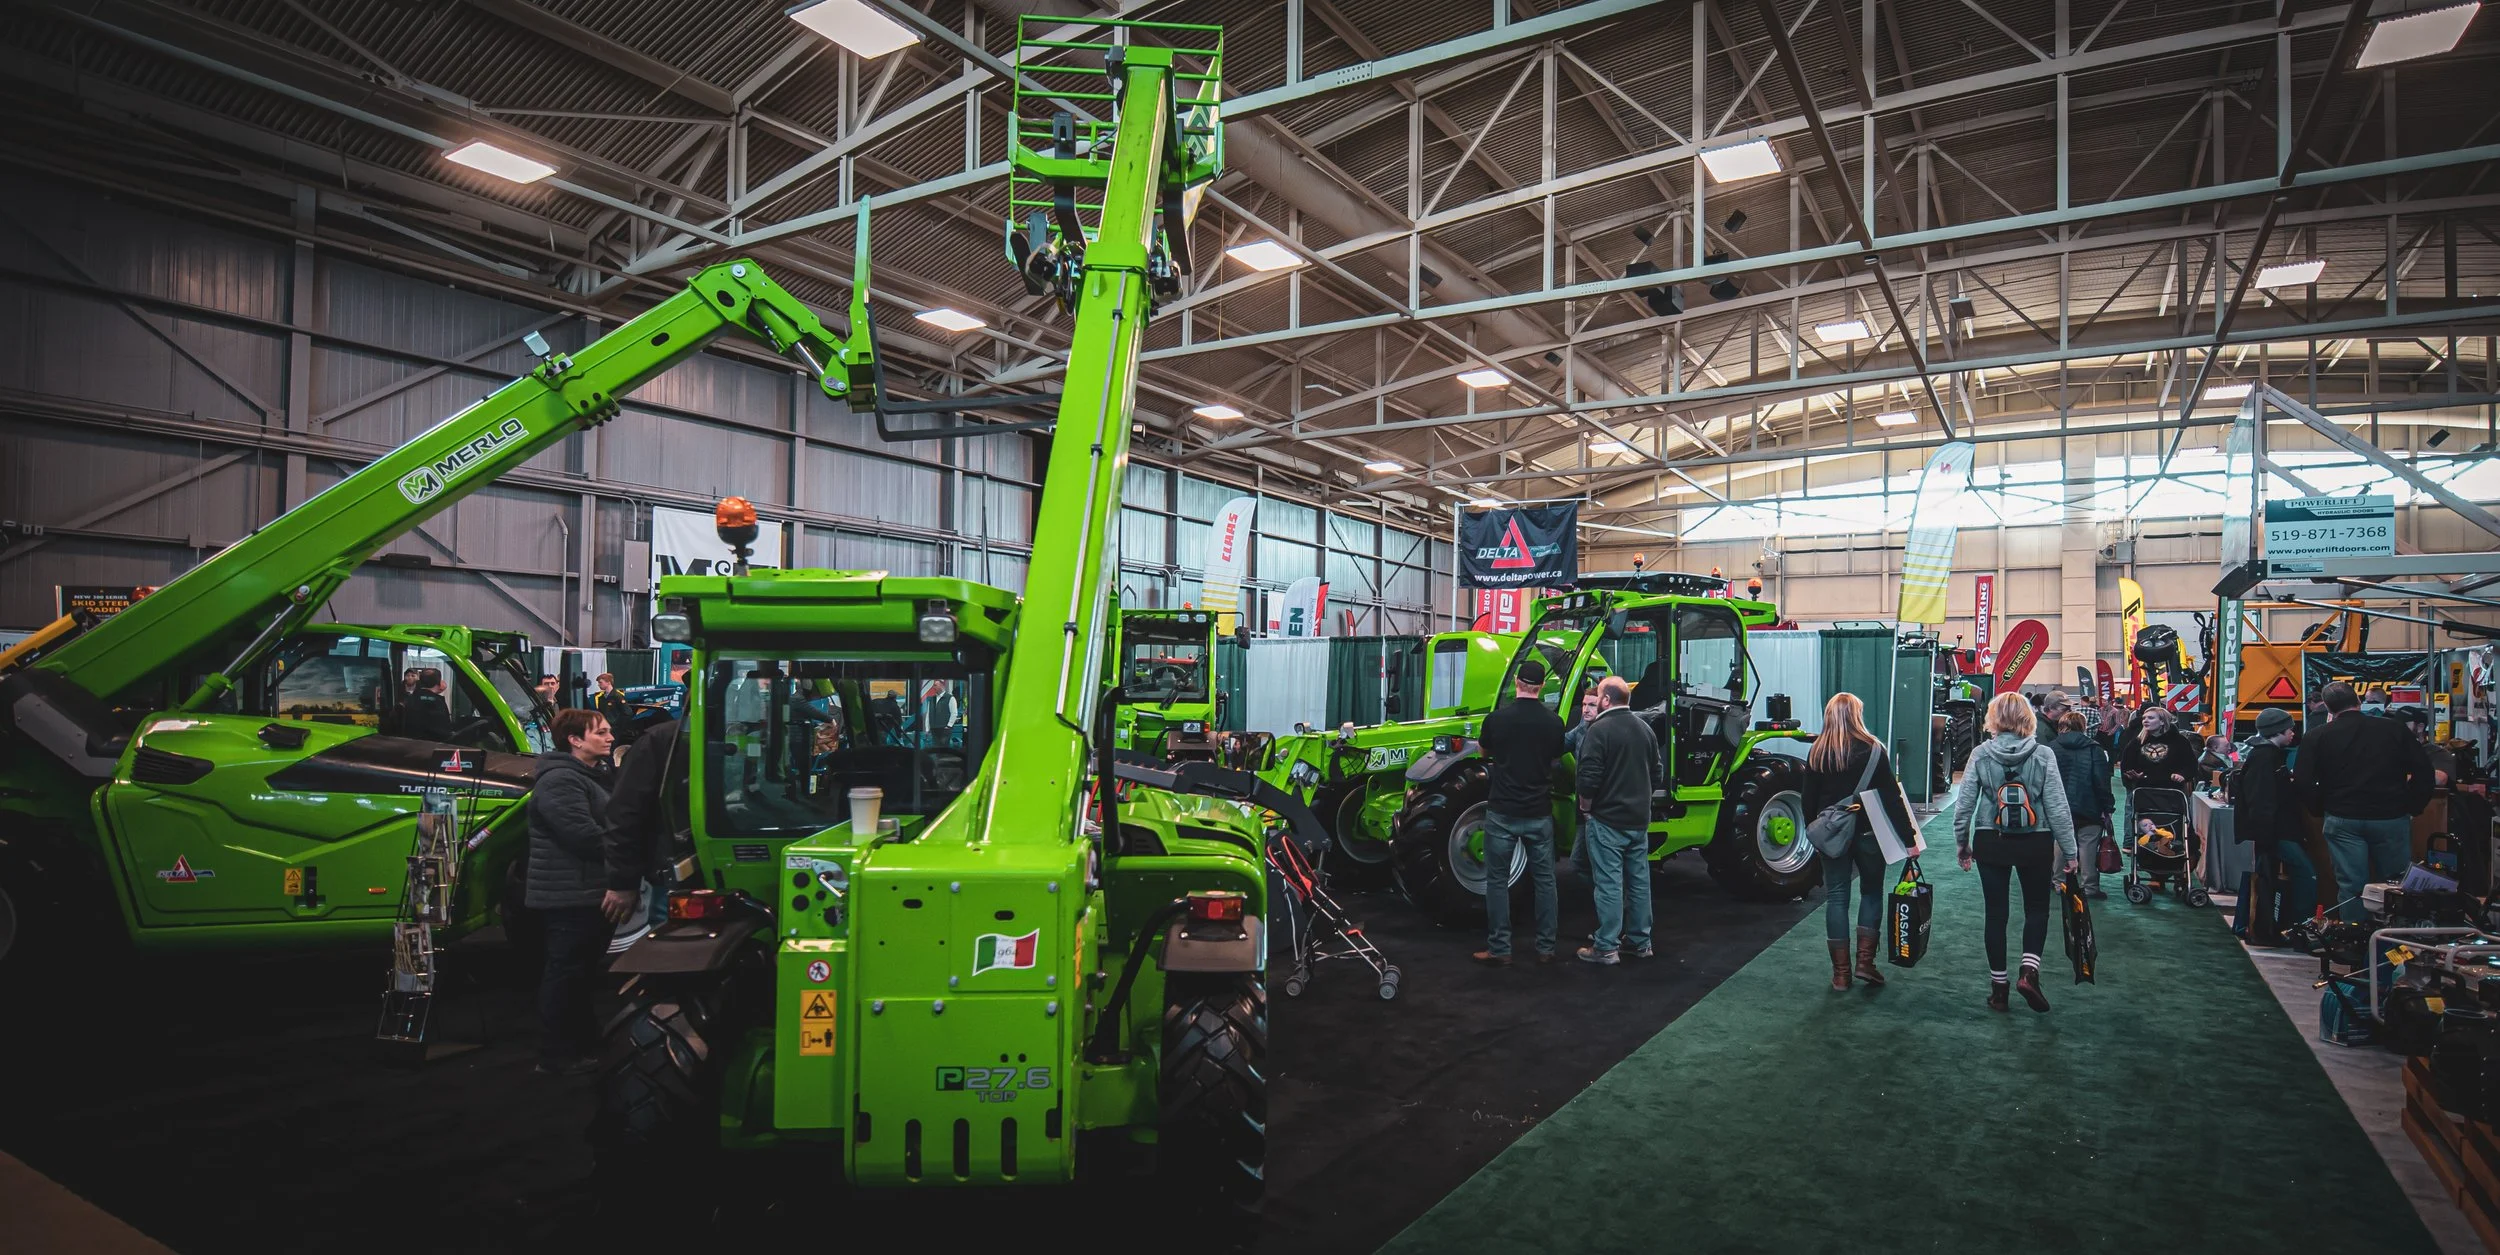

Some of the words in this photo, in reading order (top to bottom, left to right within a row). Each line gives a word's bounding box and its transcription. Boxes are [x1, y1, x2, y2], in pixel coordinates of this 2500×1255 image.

[434, 418, 522, 476] MERLO
[2290, 498, 2358, 507] POWERLIFT
[1222, 512, 1239, 562] CLAAS
[2271, 526, 2387, 541] 519-871-7368
[1477, 548, 1518, 558] DELTA
[2268, 545, 2390, 555] www.powerliftdoors.com
[1474, 570, 1562, 583] www.deltapower.ca
[1979, 582, 1988, 644] SILOKING
[2224, 600, 2238, 712] HURON
[936, 1066, 1051, 1090] P27.6
[976, 1091, 1017, 1103] TOP
